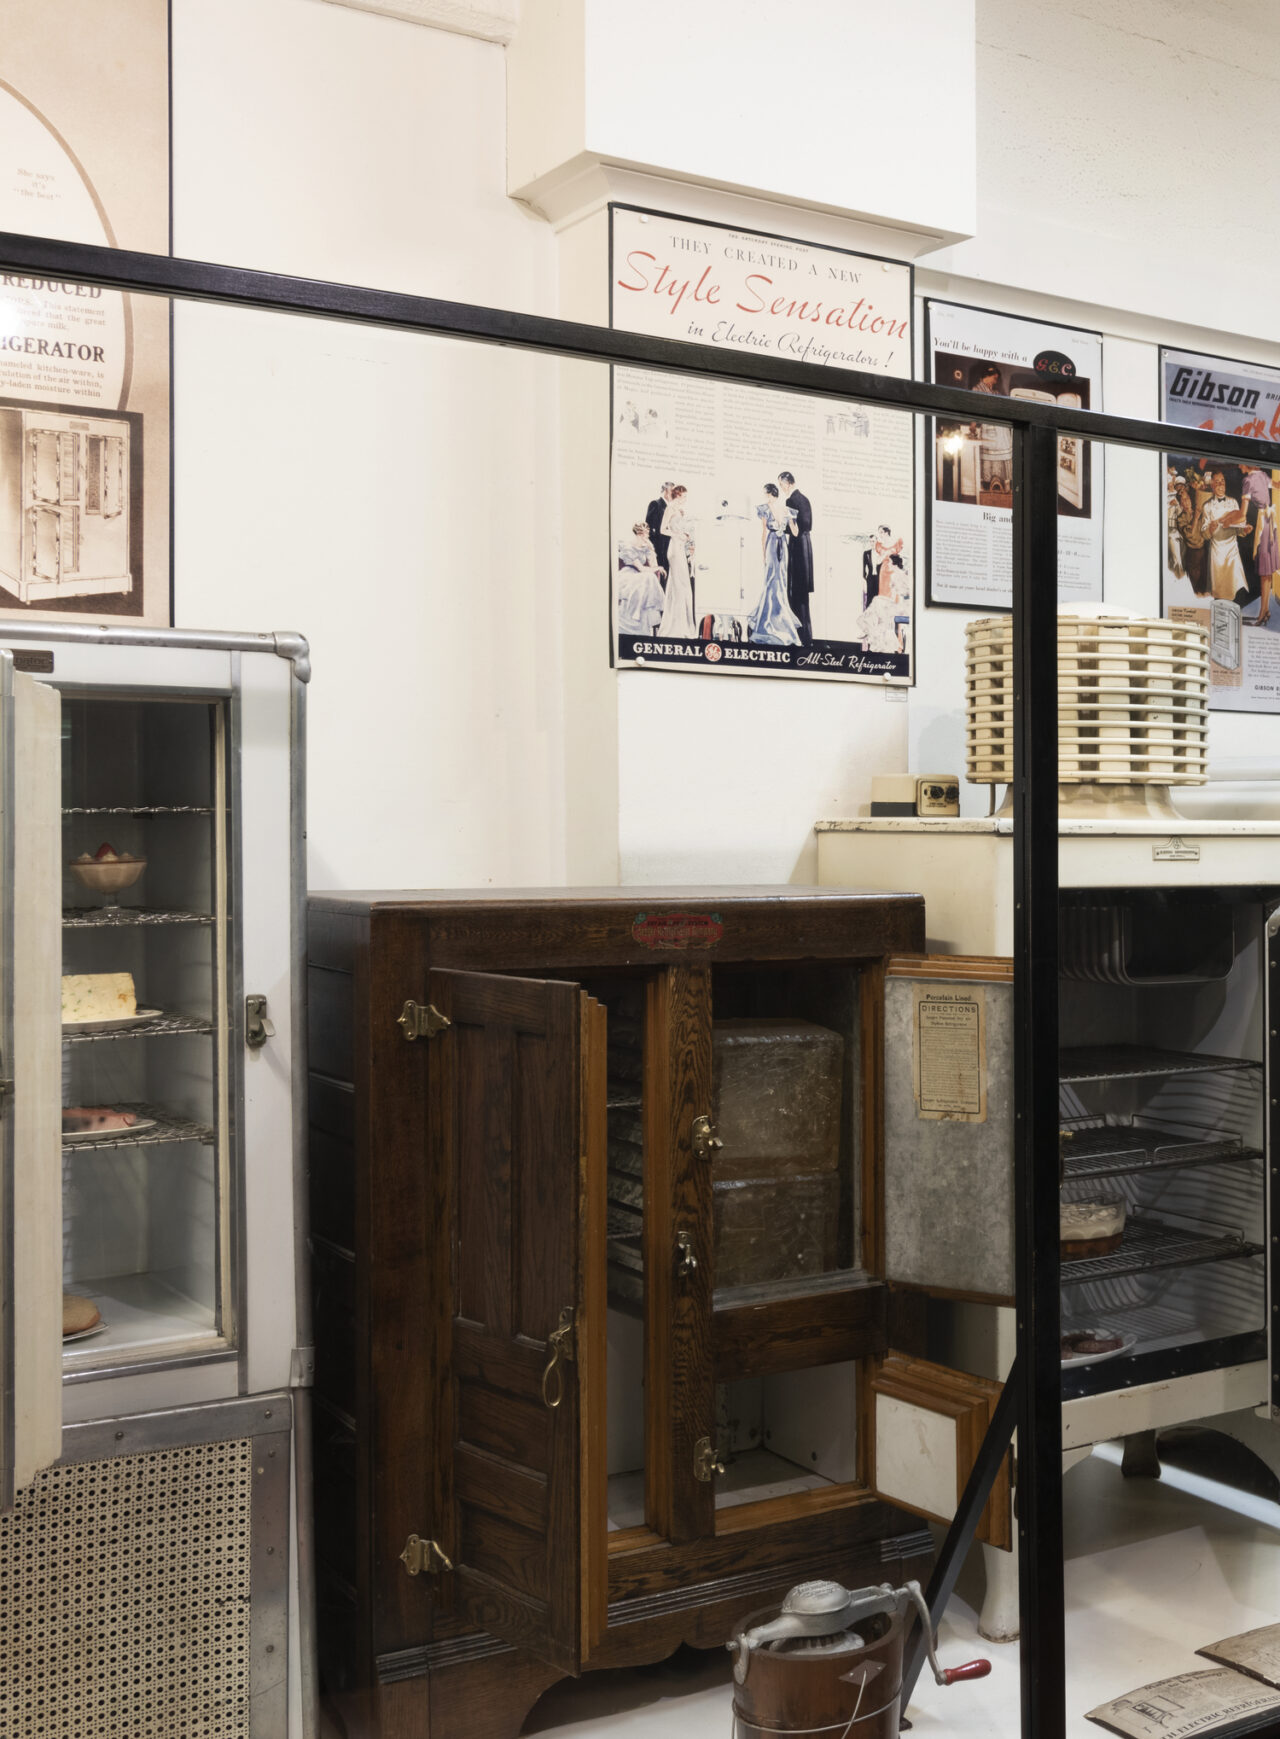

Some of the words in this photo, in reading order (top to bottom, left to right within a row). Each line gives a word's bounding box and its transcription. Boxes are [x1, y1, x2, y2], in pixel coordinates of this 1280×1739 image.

[669, 235, 712, 255] THEY
[723, 247, 798, 271] CREATED
[808, 264, 818, 276] A
[828, 267, 864, 284] NEW
[3, 274, 102, 299] REDUCED
[617, 250, 720, 315] Style
[736, 274, 908, 339] Sensation
[687, 321, 704, 336] in
[711, 320, 772, 348] Electric
[777, 332, 878, 366] Refrigerators
[961, 341, 971, 351] be
[973, 345, 999, 360] happy
[1001, 350, 1020, 362] with
[1035, 358, 1074, 377] G.E.C.
[1169, 367, 1261, 410] Gibson
[983, 511, 996, 523] Big
[632, 642, 703, 658] GENERAL
[724, 649, 791, 663] ELECTRIC
[796, 651, 844, 668] All-Steel
[847, 655, 897, 674] Refrigerator
[1254, 684, 1275, 692] GIBSON
[926, 993, 953, 1001] Porcelain
[921, 1005, 977, 1013] DIRECTIONS
[1176, 1711, 1224, 1734] ELECTRIC
